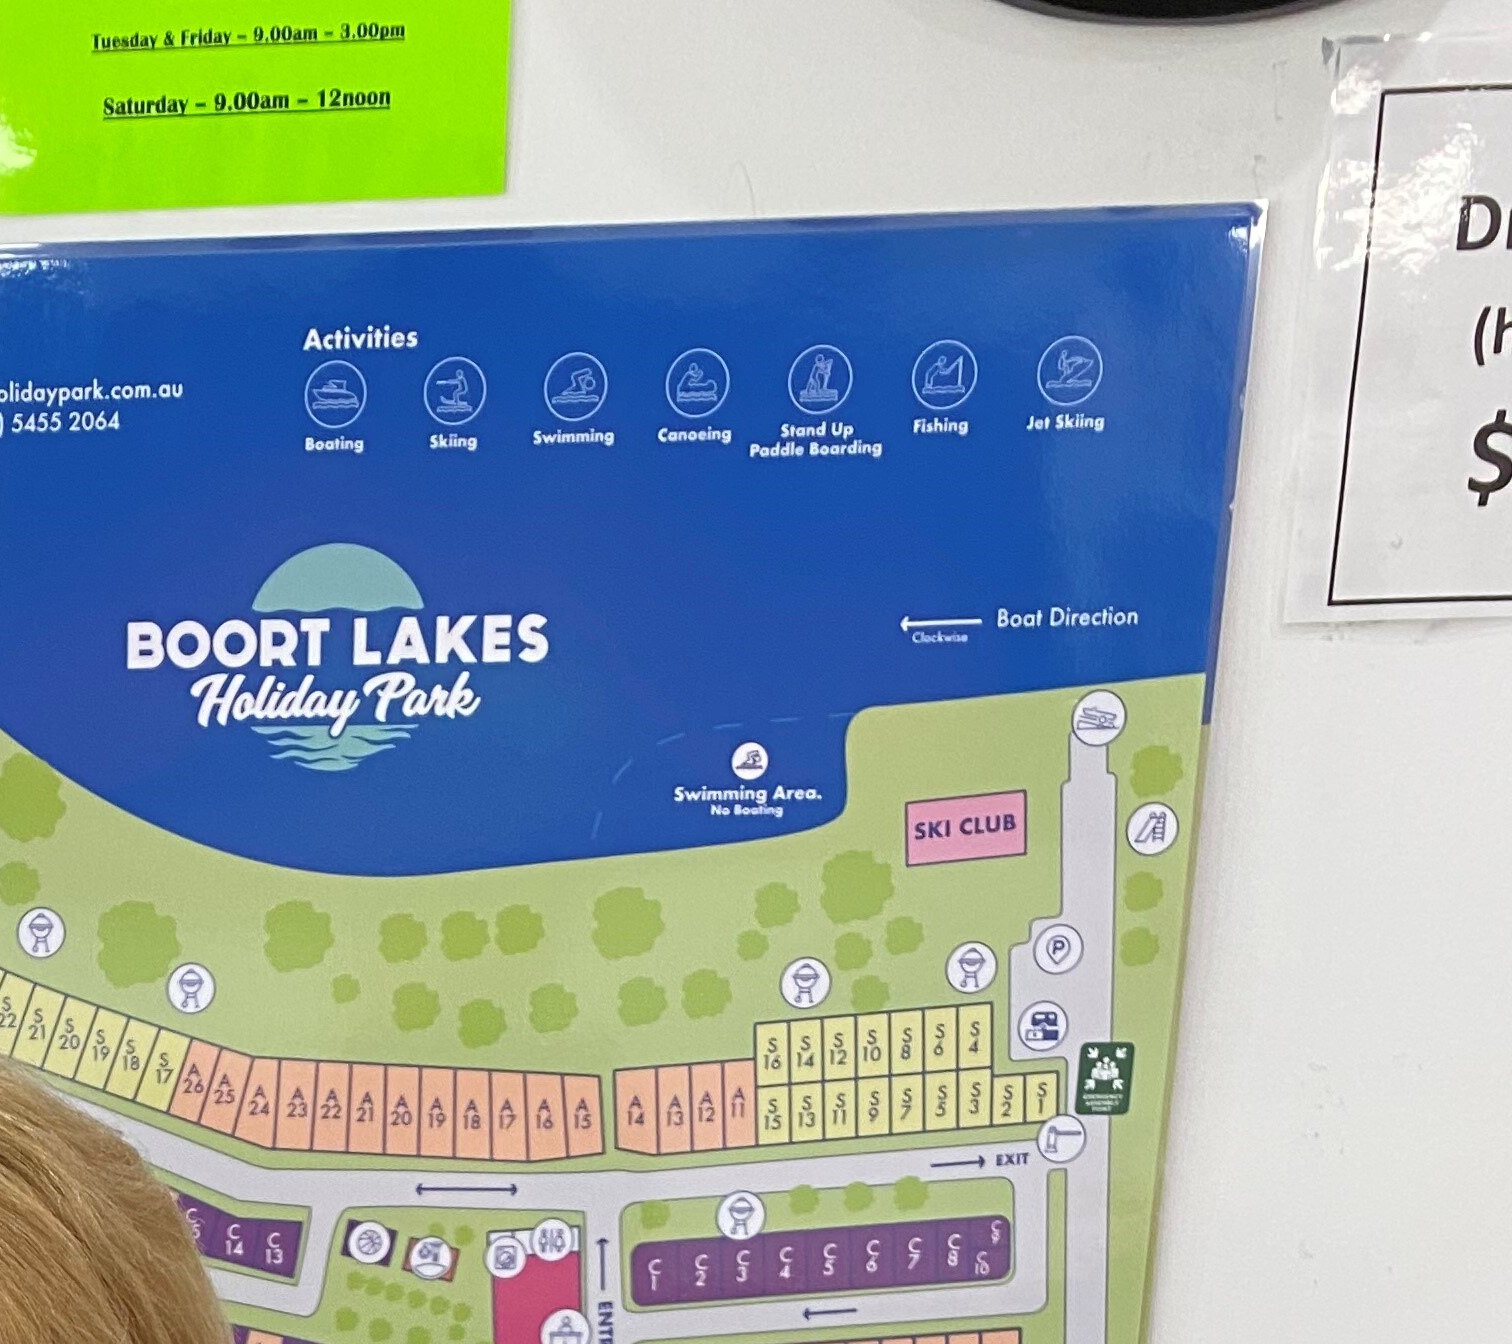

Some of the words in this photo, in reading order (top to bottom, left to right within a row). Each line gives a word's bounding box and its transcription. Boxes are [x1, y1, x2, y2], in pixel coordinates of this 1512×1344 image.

[92, 32, 157, 49] Tuesday
[163, 30, 174, 46] &
[181, 27, 231, 46] Friday
[254, 25, 318, 42] 9.00am
[341, 22, 405, 40] 3.00pm
[103, 95, 188, 116] Saturday
[214, 91, 289, 111] 9.00am
[318, 88, 390, 107] 12noon
[303, 325, 418, 352] Activities
[12, 414, 62, 433] 5455
[69, 411, 120, 431] 2064
[781, 423, 826, 438] Stand
[831, 422, 854, 439] Up
[913, 418, 969, 436] Fishing
[1026, 416, 1050, 432] Jet
[1055, 414, 1105, 431] Skiing
[305, 436, 364, 454] Boating
[430, 434, 478, 451] Skiing
[533, 429, 615, 446] Swimming
[658, 428, 732, 445] Canoeing
[749, 442, 804, 458] Paddle
[810, 441, 882, 458] Boarding
[997, 609, 1043, 628] Boat
[1050, 607, 1138, 627] Direction
[127, 617, 330, 669] BOORT
[353, 613, 549, 665] LAKES
[190, 673, 360, 736] Holiday
[363, 671, 481, 722] Park
[674, 786, 768, 804] Swimming
[773, 786, 822, 801] Area.
[710, 805, 730, 816] No
[734, 805, 783, 818] Boating
[914, 820, 951, 840] SKI
[960, 813, 1016, 836] CLUB
[996, 1152, 1029, 1166] EXIT
[268, 1232, 280, 1248] C
[266, 1249, 283, 1265] 13
